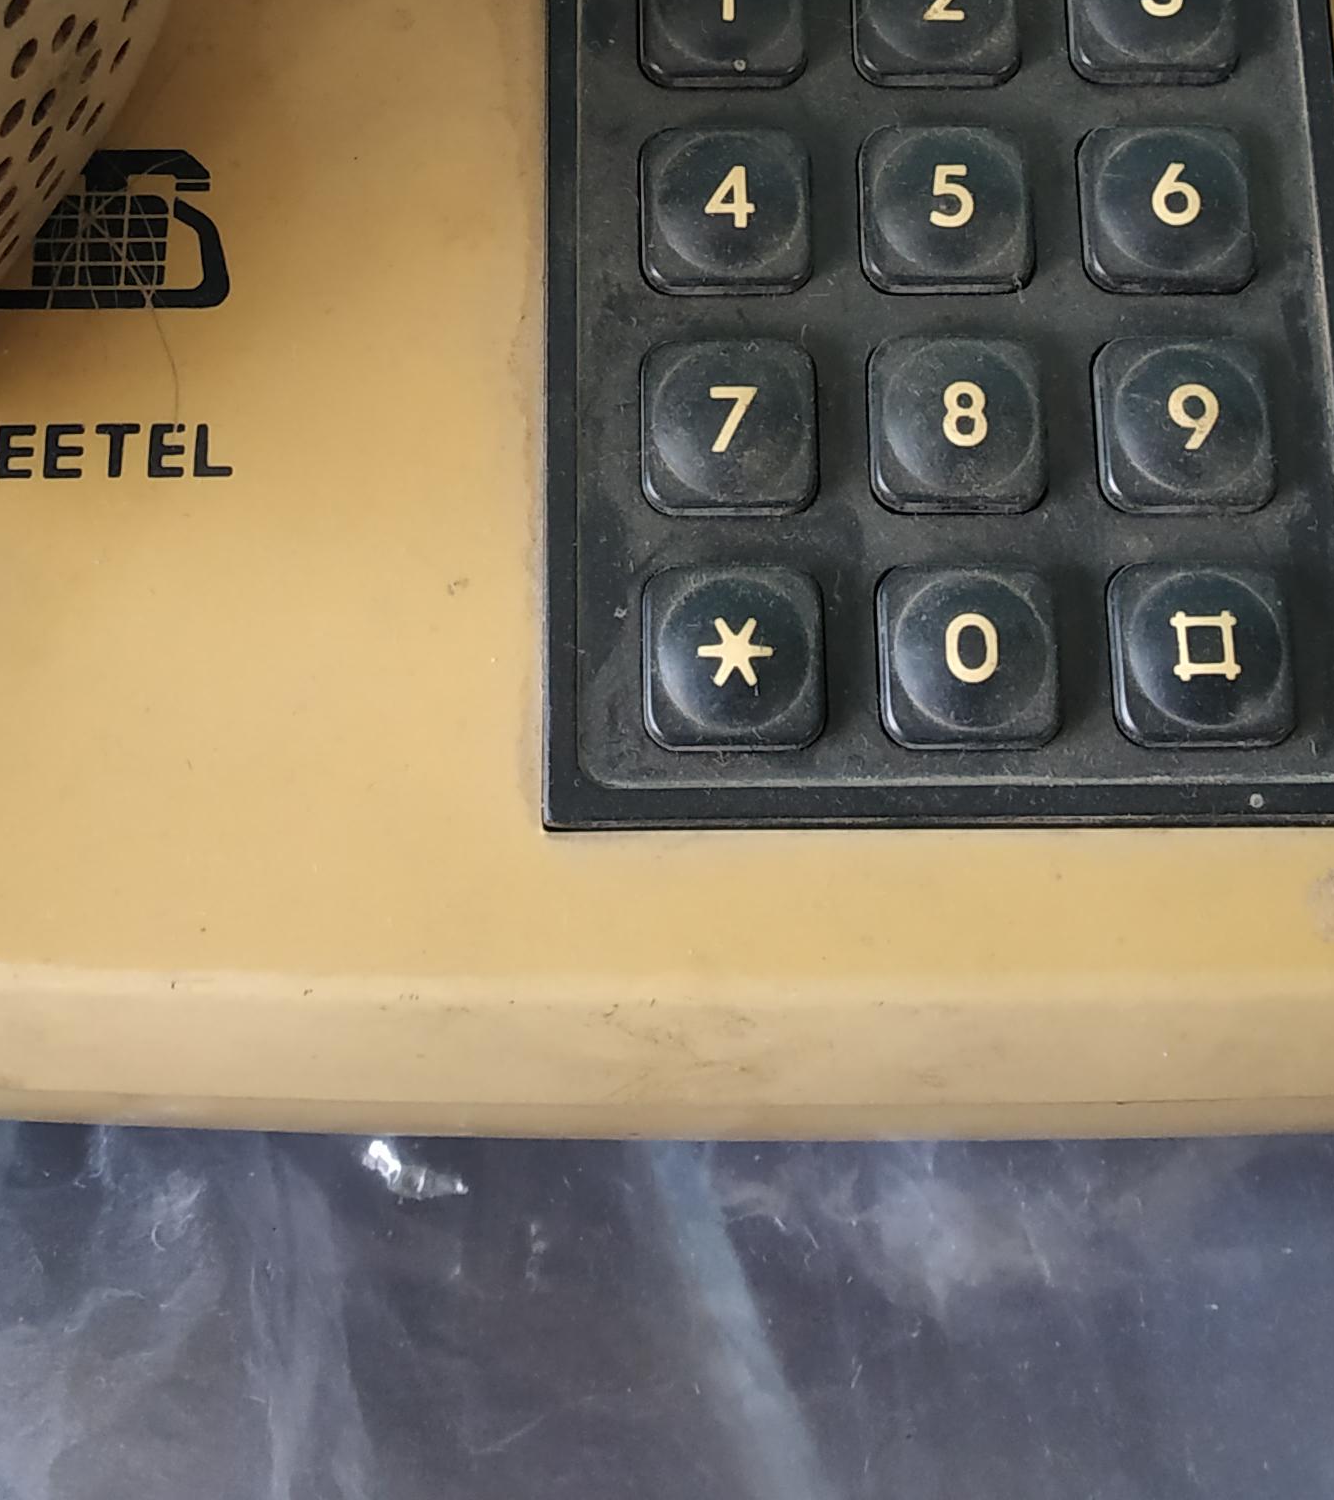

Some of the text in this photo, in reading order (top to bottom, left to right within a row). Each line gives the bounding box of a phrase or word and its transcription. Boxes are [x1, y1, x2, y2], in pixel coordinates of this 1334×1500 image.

[704, 165, 755, 228] 4
[929, 164, 974, 228] 5
[1151, 162, 1201, 226] 6
[709, 386, 758, 453] 7
[942, 381, 988, 447] 8
[1167, 383, 1219, 450] 9
[945, 613, 998, 683] 0
